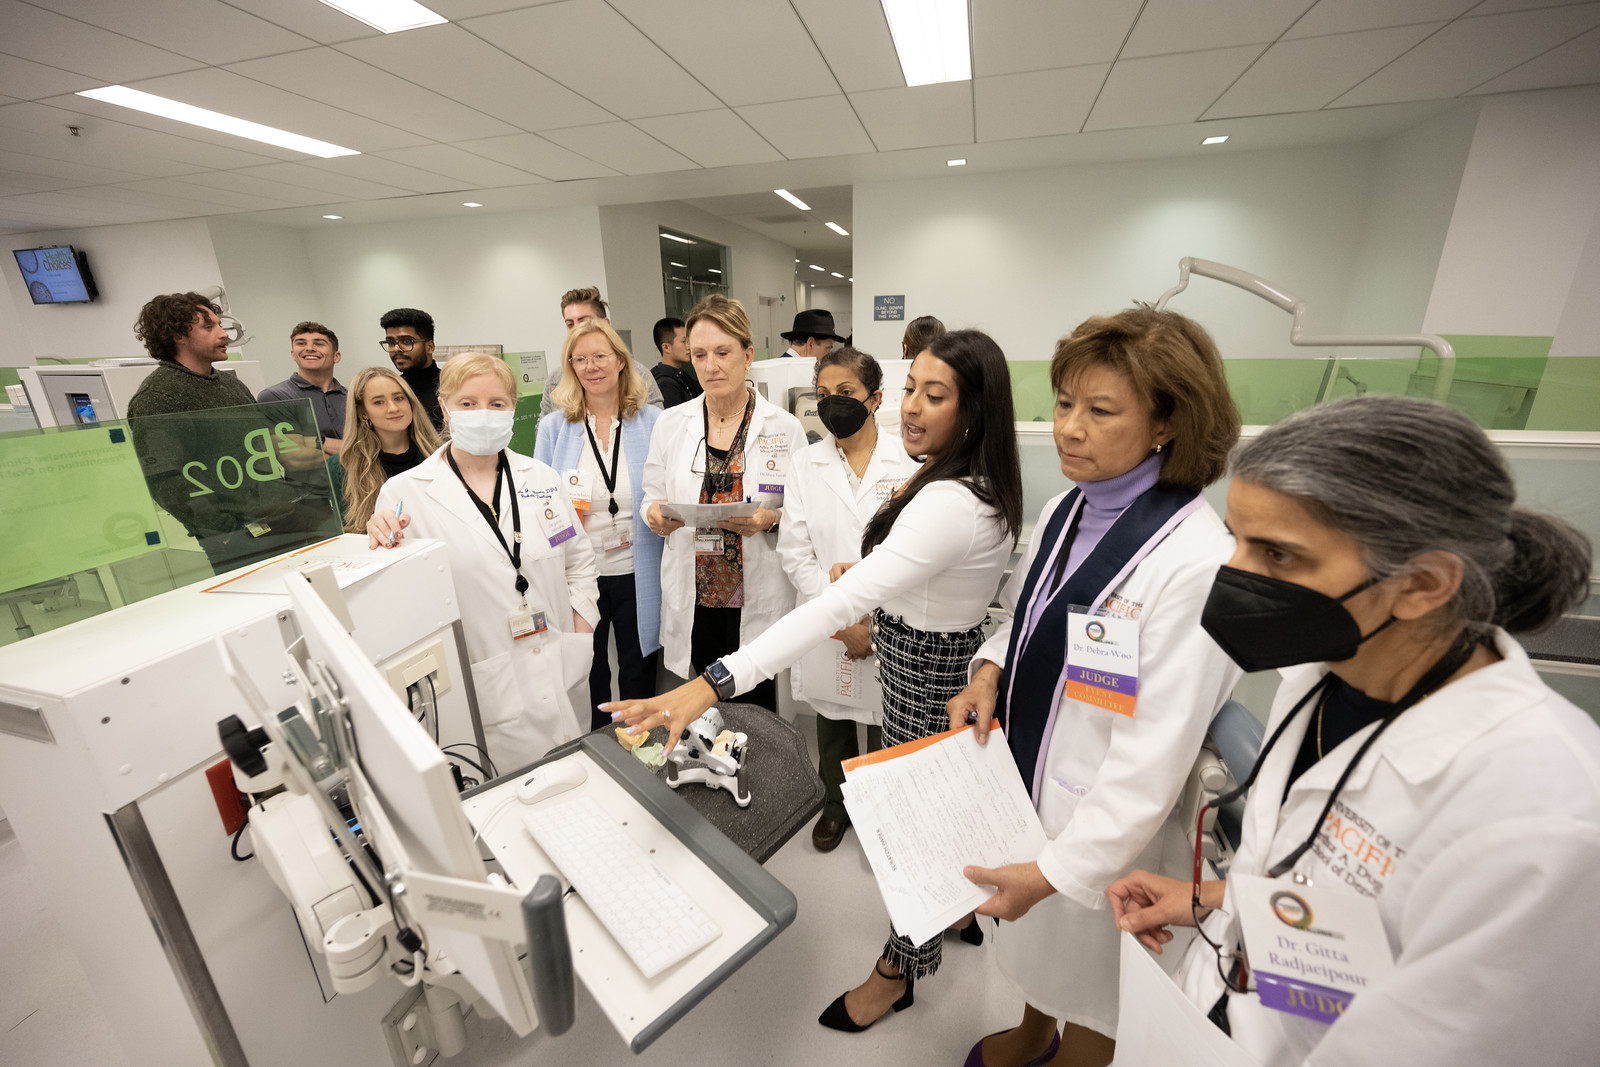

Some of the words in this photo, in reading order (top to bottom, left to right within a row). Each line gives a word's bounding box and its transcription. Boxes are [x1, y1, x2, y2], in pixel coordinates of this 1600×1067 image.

[43, 259, 72, 271] Choices
[1073, 643, 1084, 652] Dr.
[1086, 645, 1109, 657] Debra
[1111, 649, 1132, 660] Woo
[1080, 669, 1120, 688] JUDGE
[1073, 691, 1124, 712] COMMITTEE
[1326, 810, 1397, 877] PACIFI
[883, 846, 897, 871] SCRATCH
[1277, 936, 1300, 951] Dr.
[1305, 940, 1350, 964] Gitta
